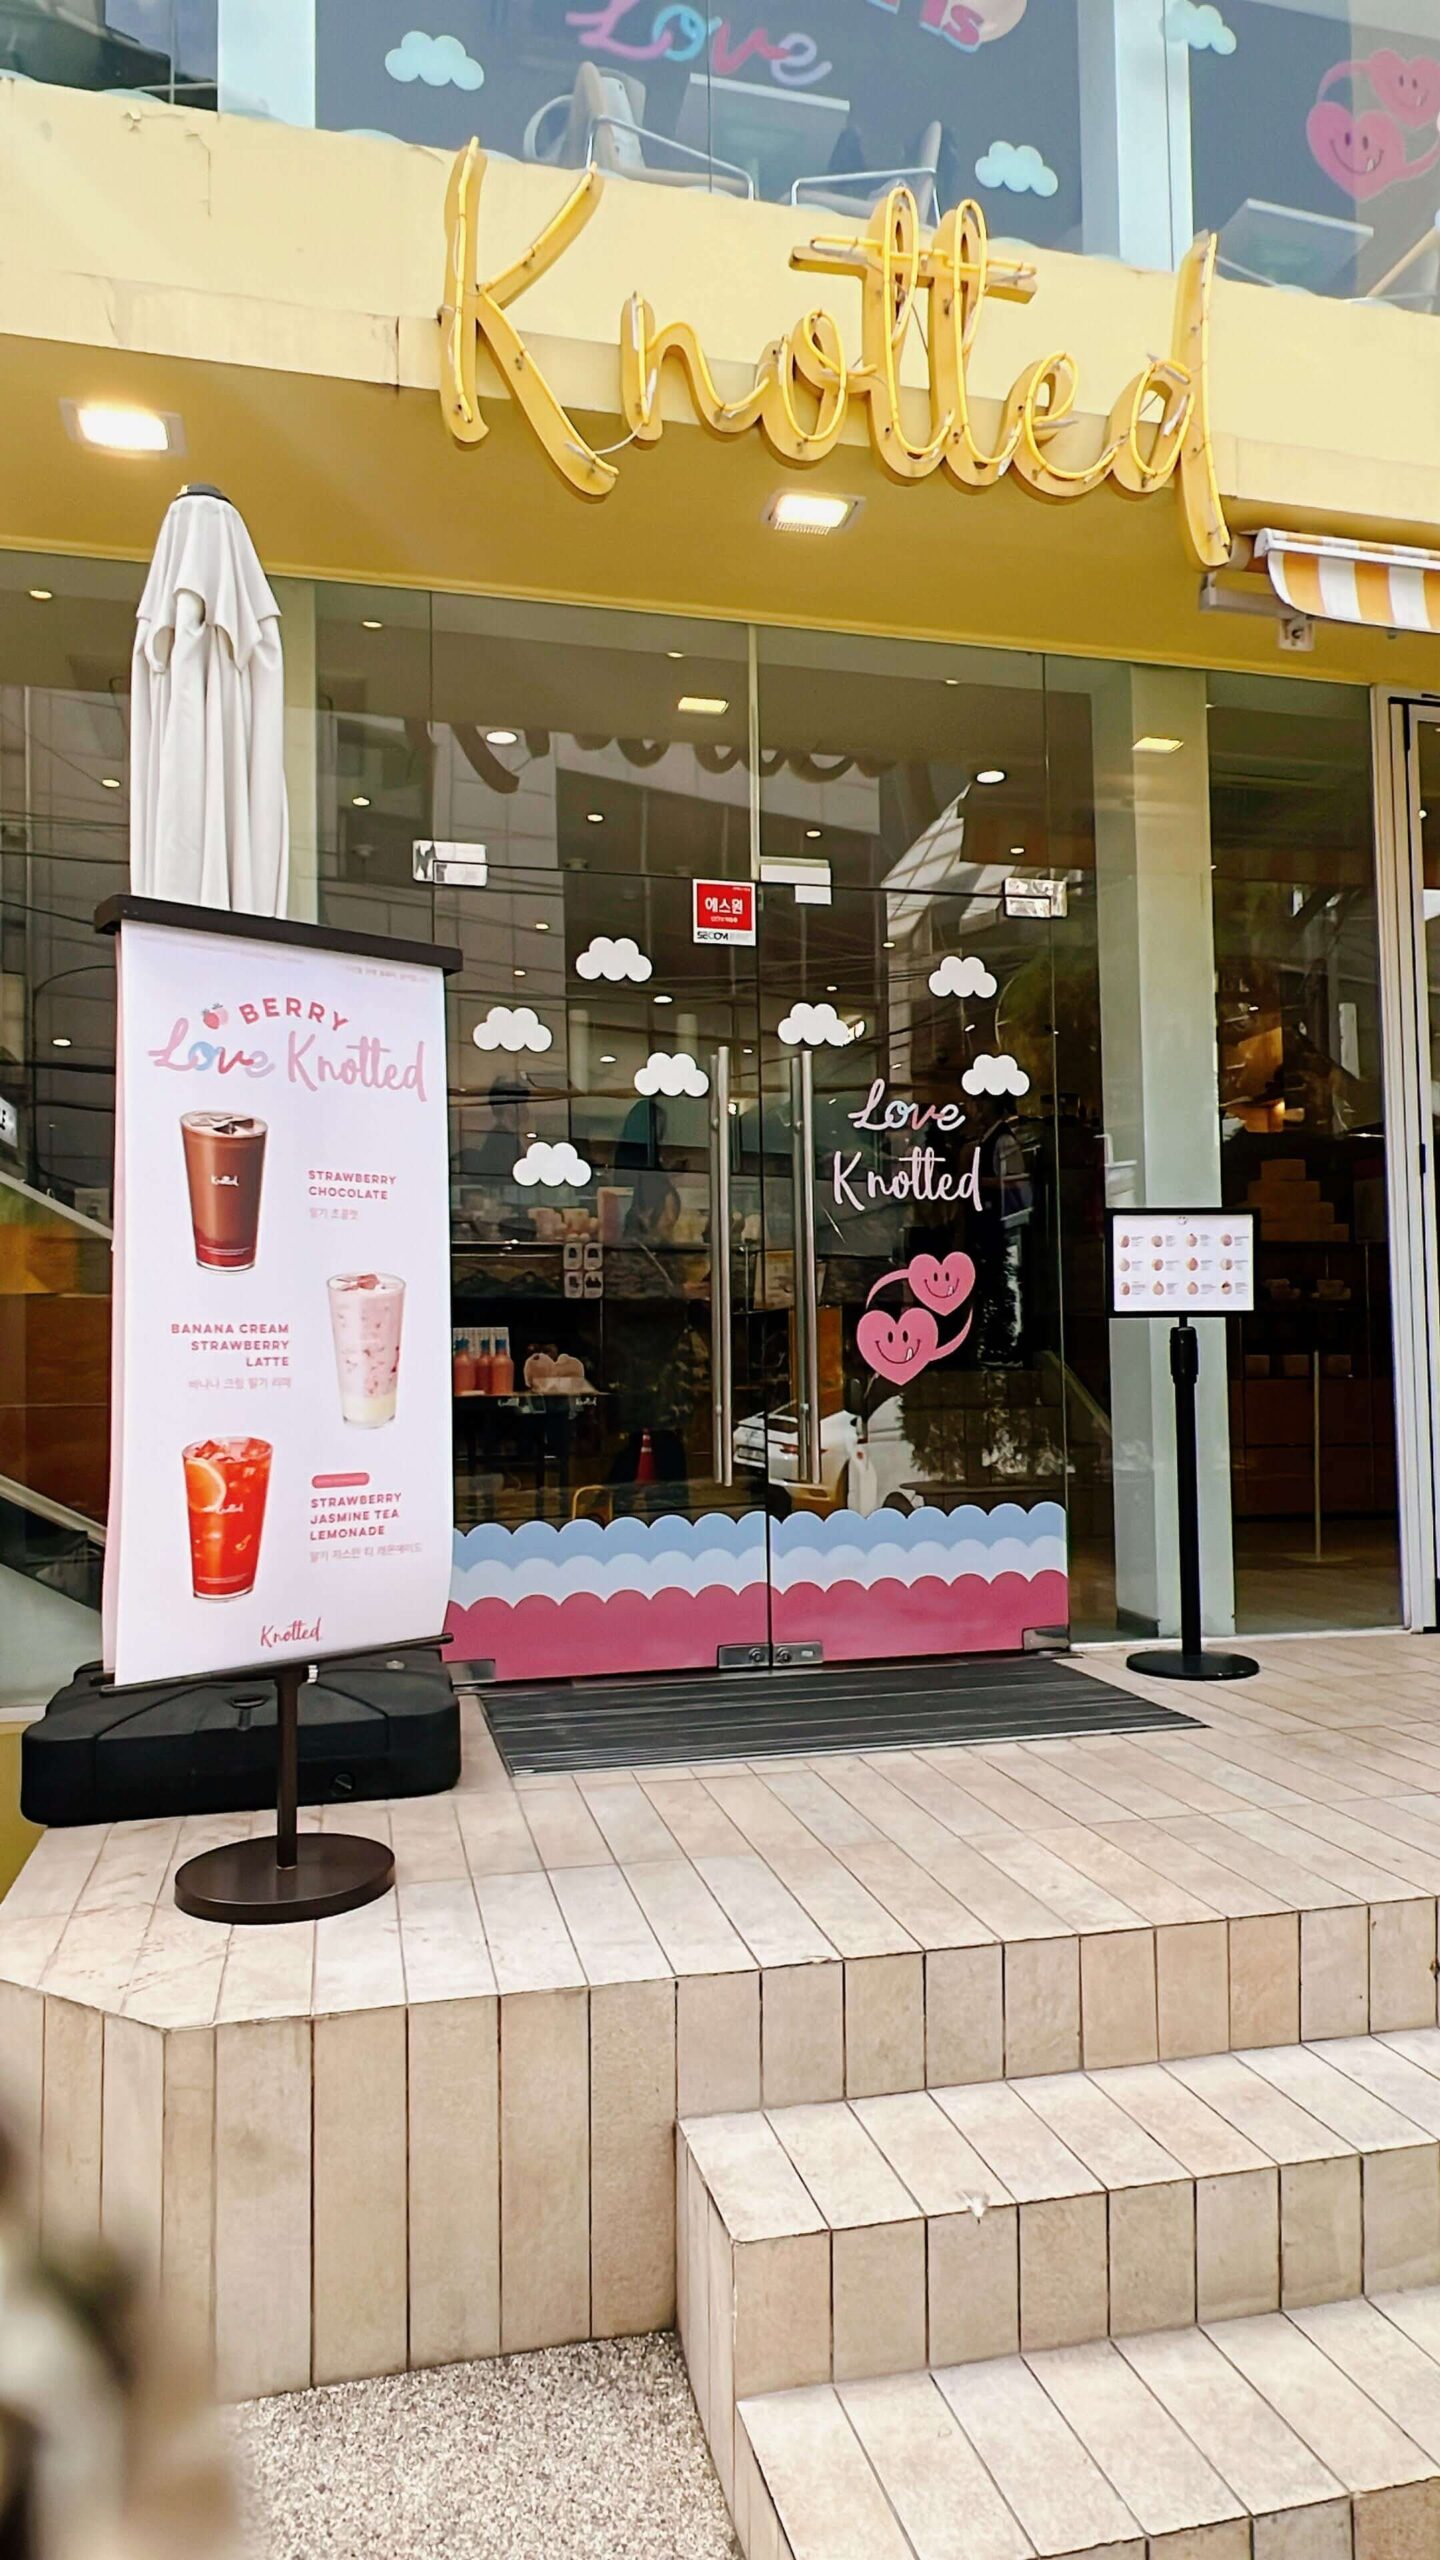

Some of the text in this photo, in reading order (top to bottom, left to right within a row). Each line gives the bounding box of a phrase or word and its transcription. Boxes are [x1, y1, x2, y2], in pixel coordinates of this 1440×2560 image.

[438, 136, 1230, 567] Knotted
[704, 896, 743, 915] 에스원
[238, 997, 349, 1031] BERRY
[148, 1017, 427, 1102] Love Knotted
[848, 1078, 966, 1131] Love
[308, 1170, 397, 1184] STRAWBERRY
[833, 1146, 983, 1212] Knotted
[308, 1186, 388, 1200] CHOCOLATE
[171, 1323, 290, 1334] BANANA CREAM
[191, 1340, 290, 1351] STRAWBERRY
[246, 1356, 290, 1367] LATTE
[311, 1492, 402, 1509] STRAWBERRY
[310, 1509, 400, 1525] JASMINE TEA
[310, 1525, 385, 1541] LEMONADE
[260, 1617, 321, 1648] Knotted
